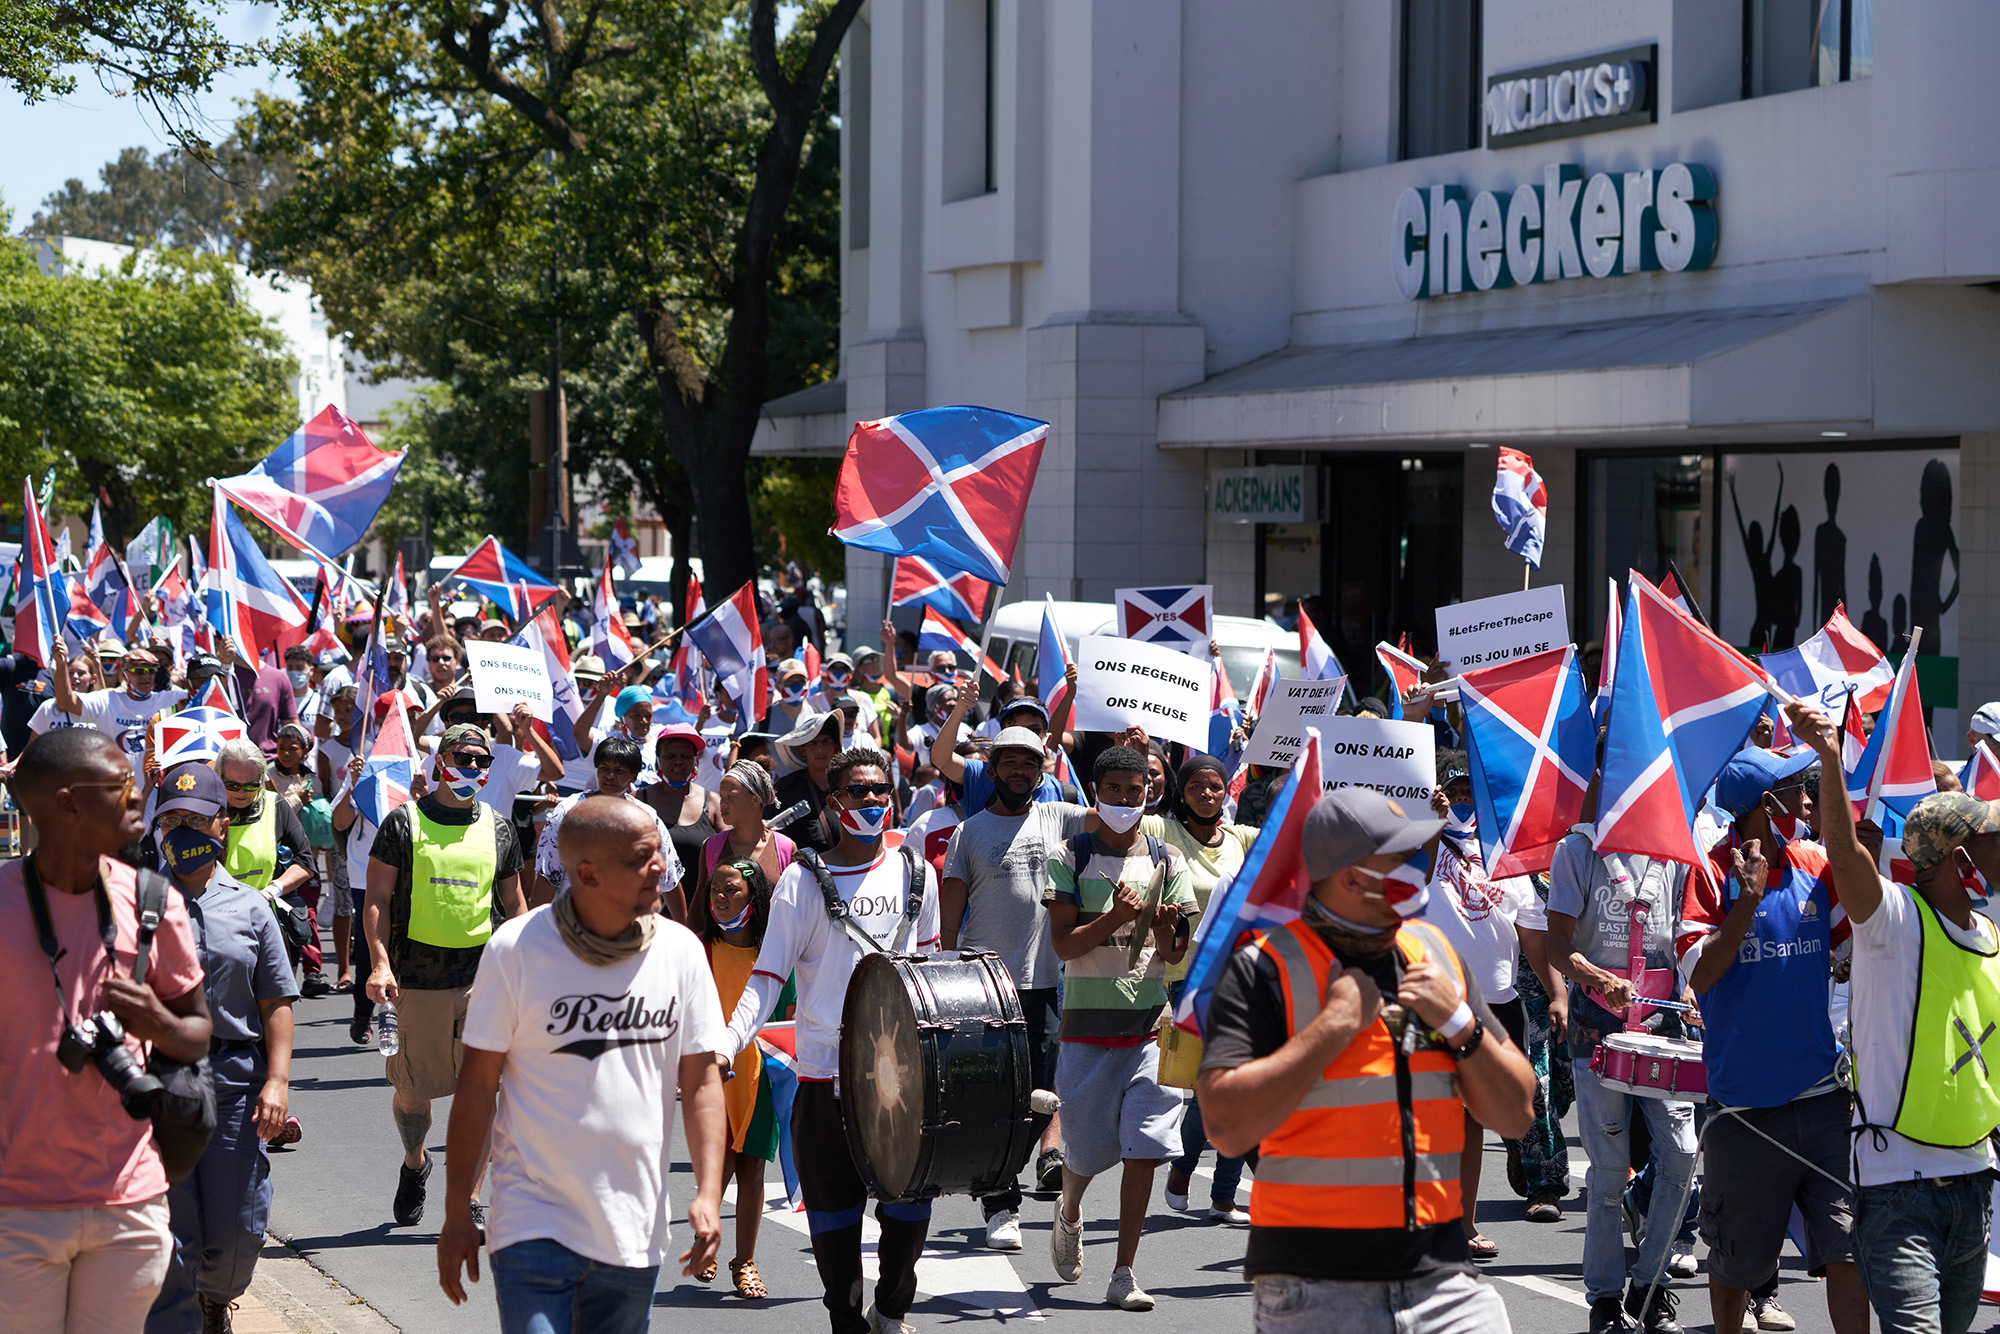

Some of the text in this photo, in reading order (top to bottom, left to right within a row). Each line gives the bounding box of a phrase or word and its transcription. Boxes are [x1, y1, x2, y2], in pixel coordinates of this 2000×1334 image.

[1510, 62, 1613, 131] CLICKS
[1214, 474, 1301, 513] ACKERMANS
[1153, 612, 1178, 622] YES
[1448, 611, 1554, 637] #LetsFreeTheCape
[1485, 648, 1510, 662] JOU
[1513, 645, 1531, 657] MA
[1534, 641, 1550, 653] SE
[480, 659, 542, 677] ONS REGERING
[1094, 660, 1200, 692] ONS REGERING
[494, 686, 542, 701] ONS KEUSE
[1287, 685, 1338, 699] VAT DIE KAA
[1105, 696, 1188, 722] ONS KEUSE
[1299, 704, 1326, 716] TERUG
[1273, 735, 1301, 747] TAKE
[1269, 750, 1294, 763] THE
[1334, 742, 1415, 760] ONS KAAP
[1322, 780, 1349, 792] NS
[182, 844, 212, 860] SAPS
[1598, 922, 1627, 933] EAST
[1609, 933, 1652, 943] TRADERK
[1762, 937, 1822, 959] Sanlam
[546, 989, 679, 1037] Redbat
